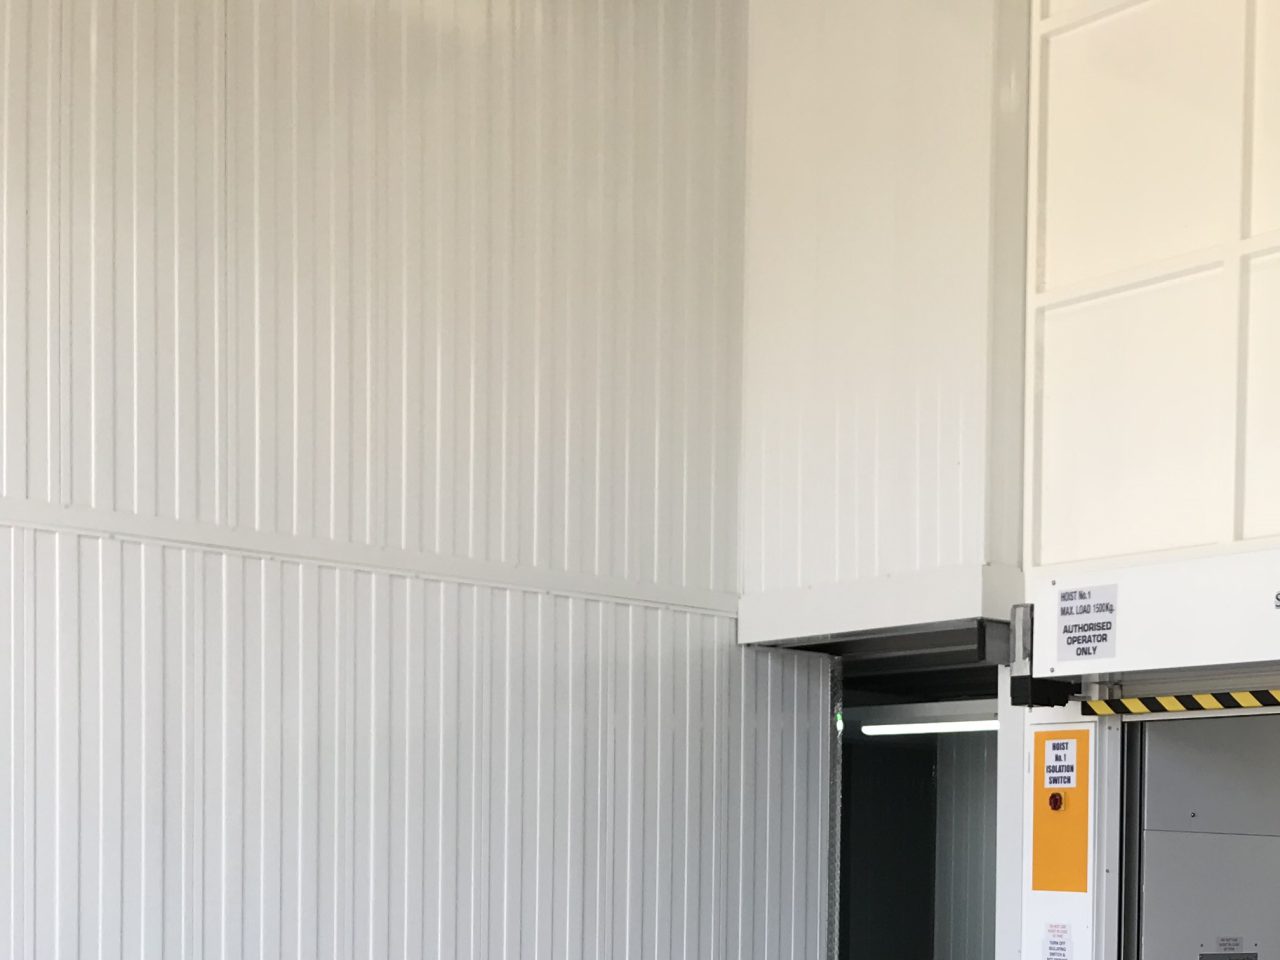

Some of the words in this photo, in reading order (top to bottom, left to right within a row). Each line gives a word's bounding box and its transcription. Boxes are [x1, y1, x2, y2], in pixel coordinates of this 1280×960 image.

[1060, 591, 1077, 602] HOIST
[1076, 604, 1091, 615] LOAD
[1062, 621, 1112, 634] AUTHORISED
[1066, 633, 1108, 645] OPERATOR
[1075, 646, 1097, 656] ONLY
[1052, 742, 1069, 751] HOIST
[1046, 764, 1074, 773] ISOLATION
[1048, 776, 1071, 784] SWITCH
